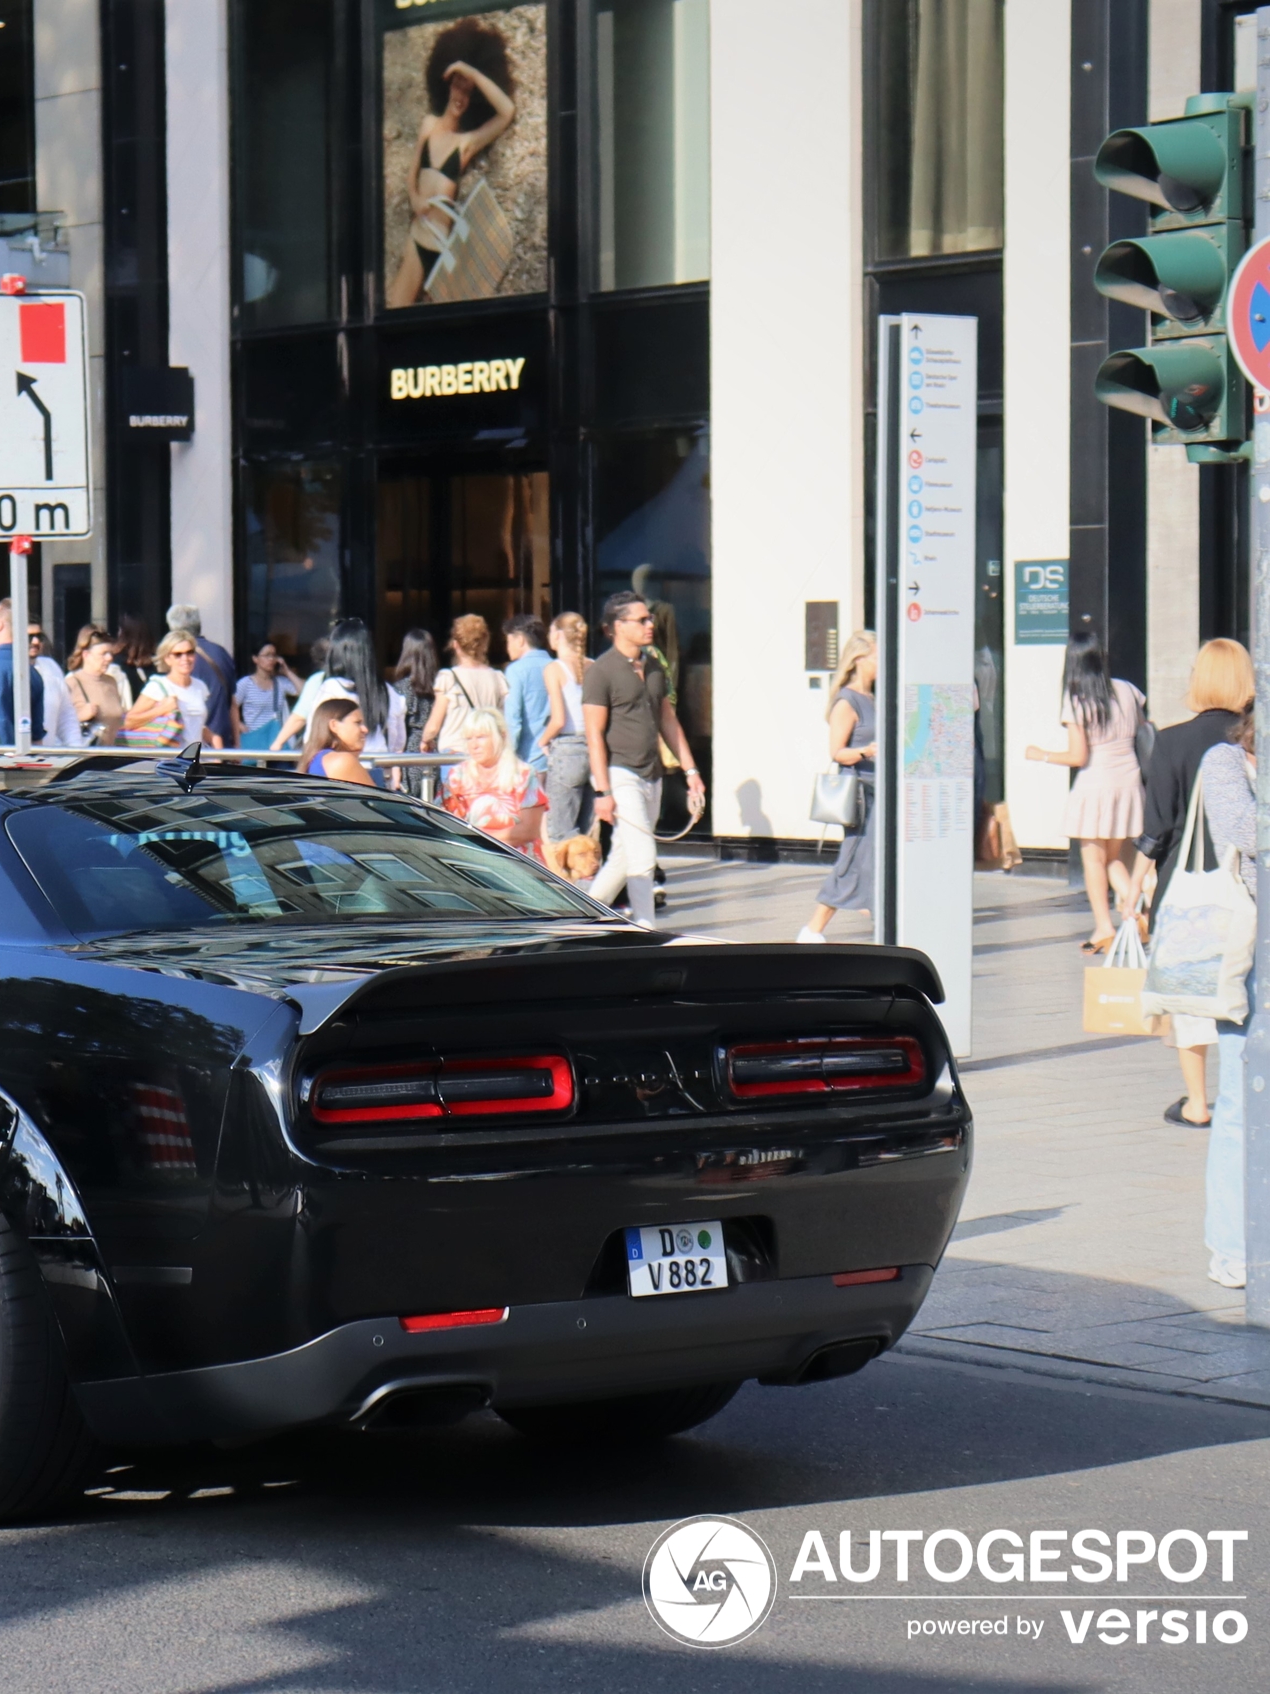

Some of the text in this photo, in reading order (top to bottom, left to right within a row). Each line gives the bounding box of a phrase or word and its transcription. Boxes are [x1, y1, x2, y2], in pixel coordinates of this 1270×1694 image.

[391, 357, 526, 400] BURBERRY
[129, 415, 189, 428] BURBERRY
[34, 502, 70, 531] m
[1023, 565, 1064, 590] DS
[1028, 594, 1060, 603] DEUTSCHE
[632, 1248, 639, 1258] D
[659, 1228, 675, 1257] D
